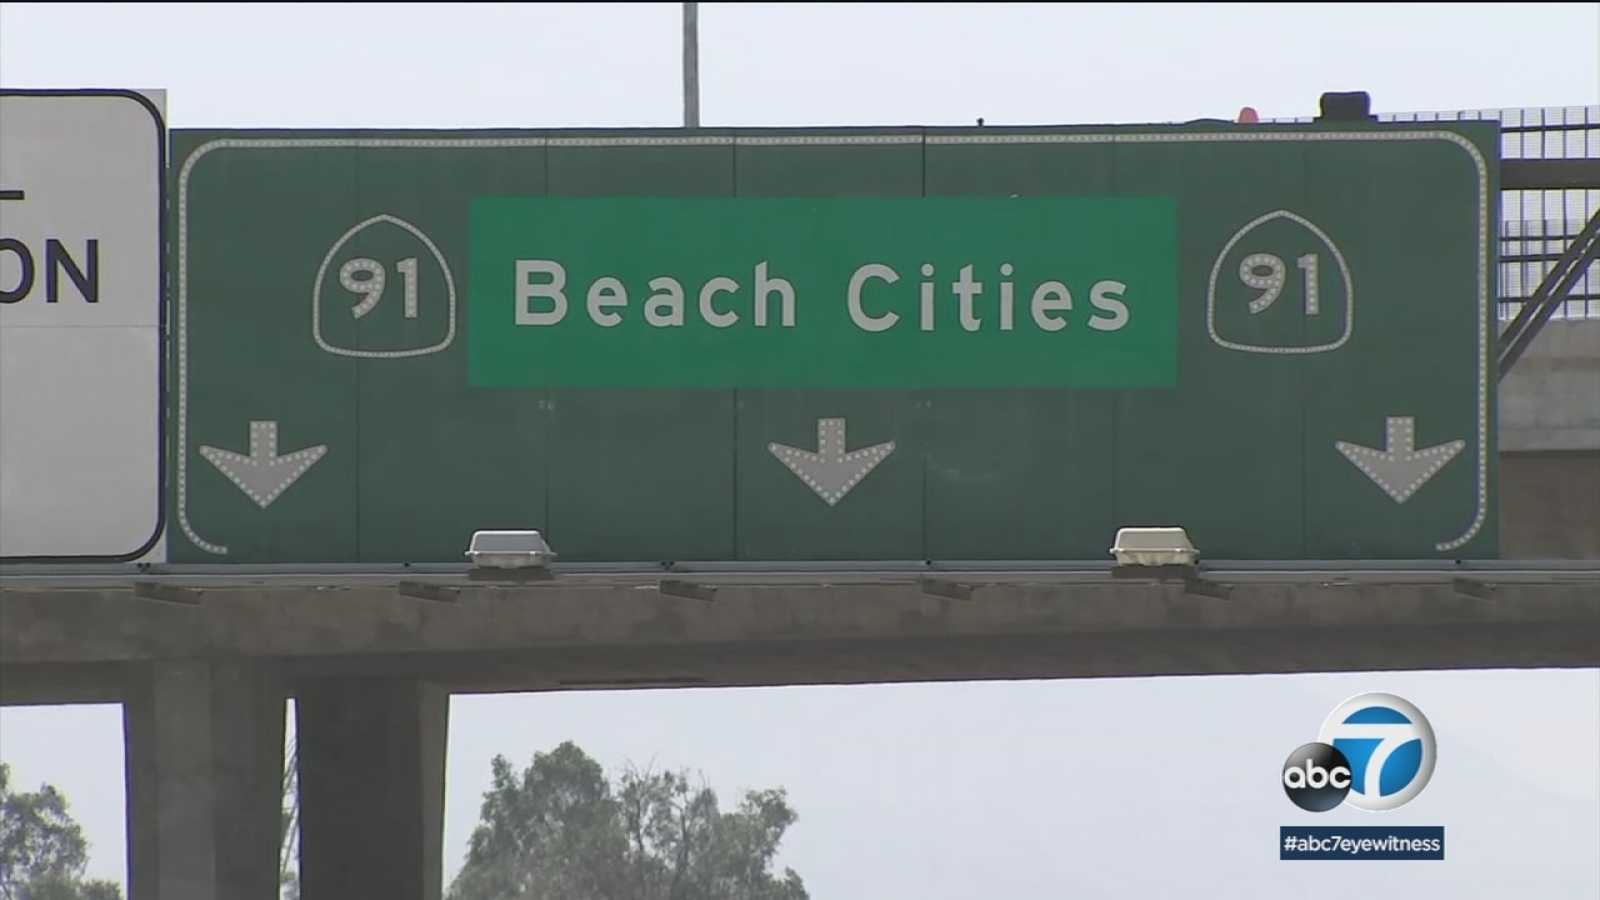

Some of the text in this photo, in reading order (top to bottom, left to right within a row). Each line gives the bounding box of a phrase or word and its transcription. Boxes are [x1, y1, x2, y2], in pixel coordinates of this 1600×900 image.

[338, 257, 419, 319] 91
[514, 259, 1132, 332] Beach Cities
[1238, 253, 1320, 316] 91
